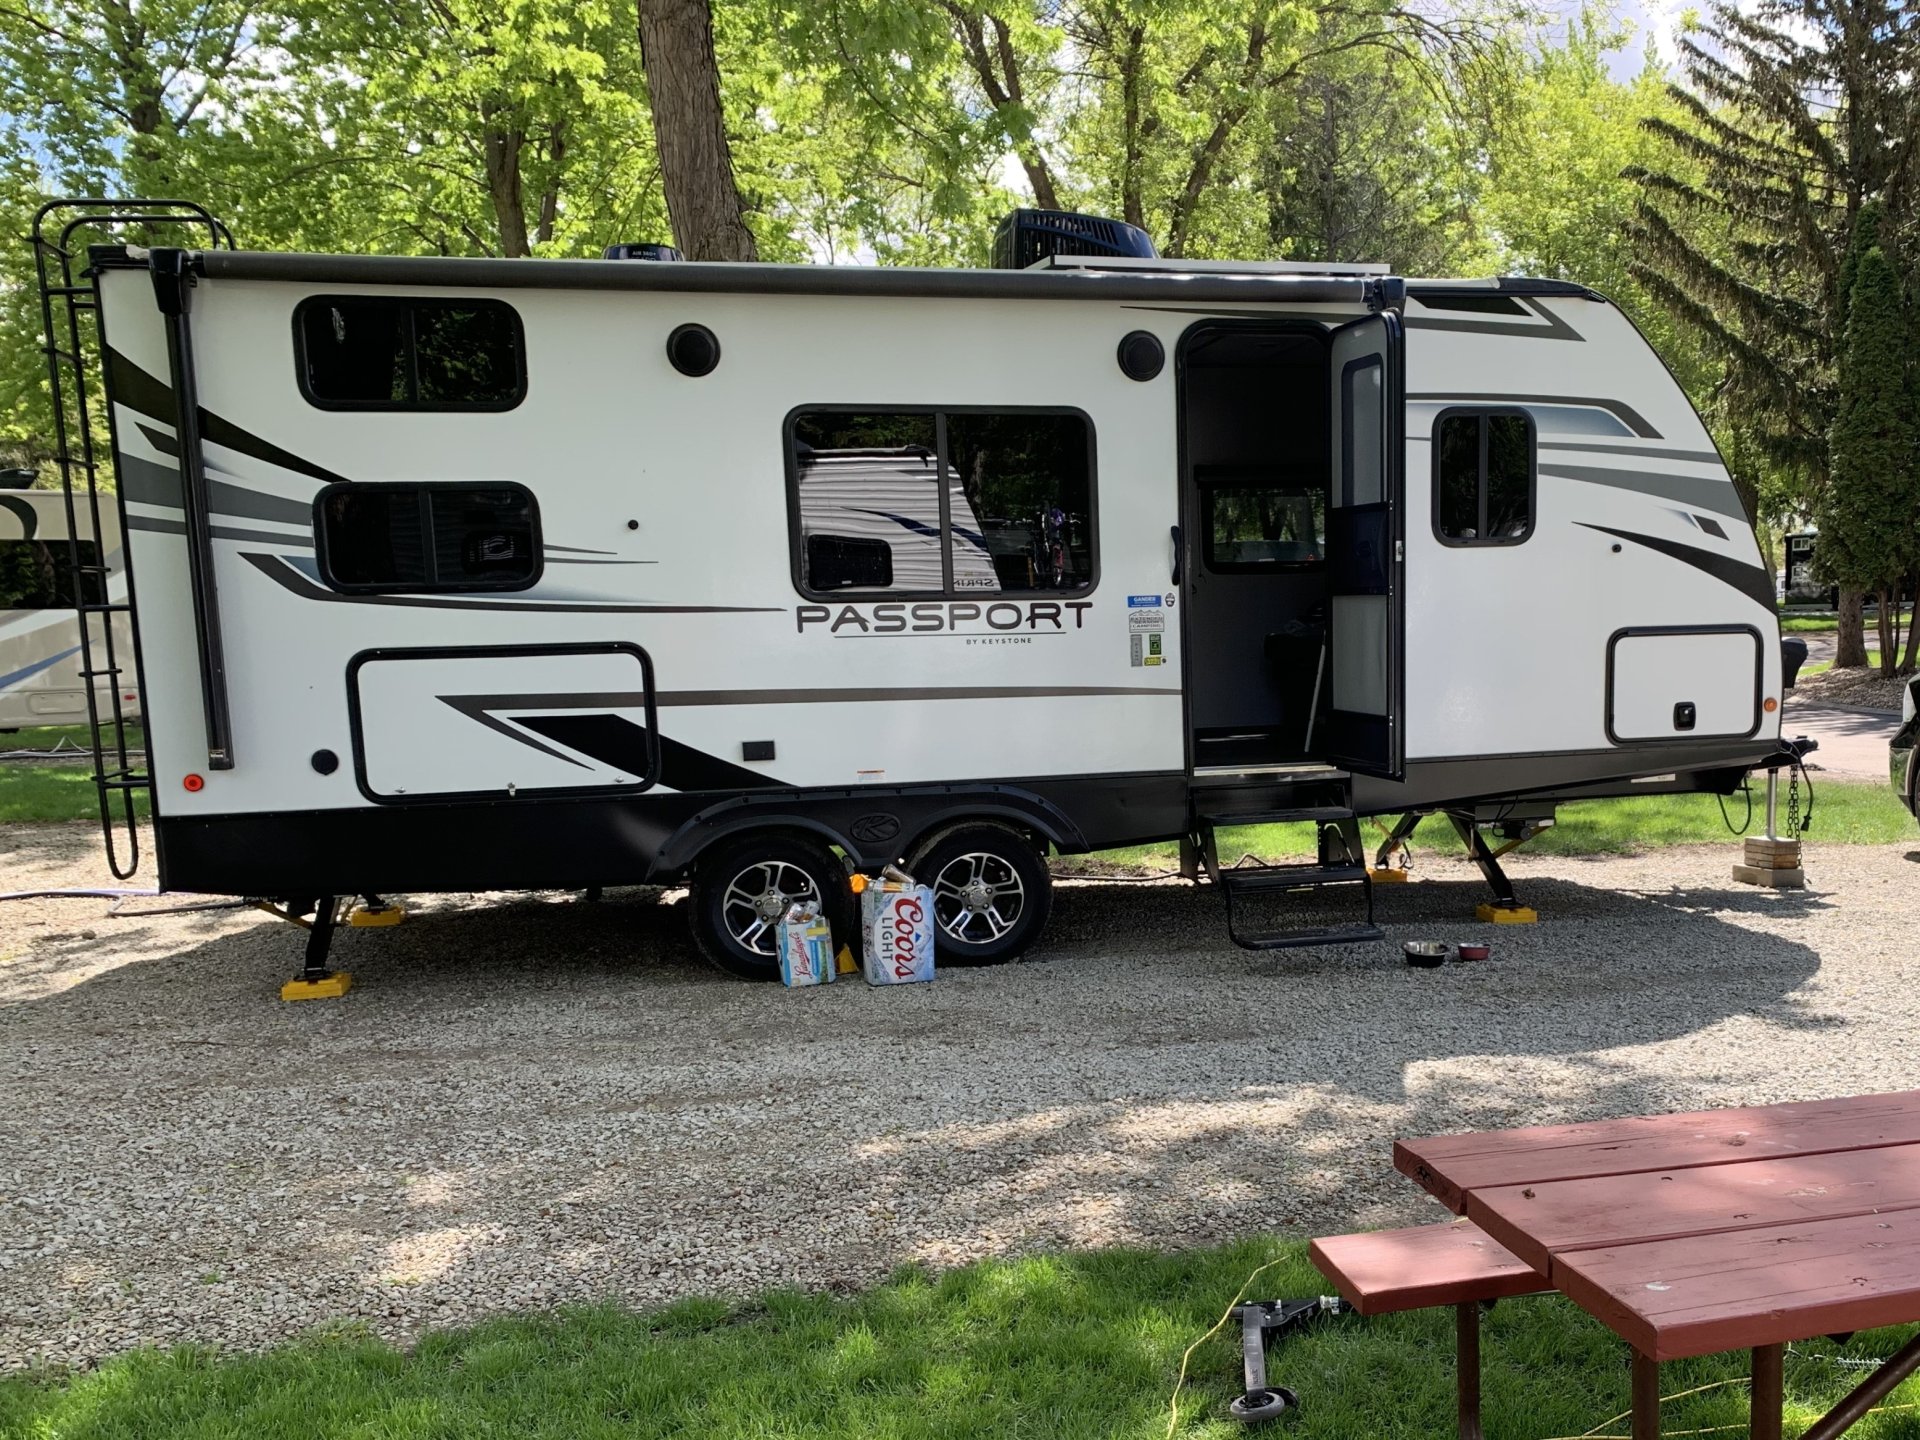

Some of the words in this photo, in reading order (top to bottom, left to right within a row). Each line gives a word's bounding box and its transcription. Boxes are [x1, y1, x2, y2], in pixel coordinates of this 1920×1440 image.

[796, 602, 1093, 634] PASSPORT
[982, 637, 1032, 645] KEYSTONE
[882, 917, 893, 960] LIGHT
[895, 896, 924, 979] Coors
